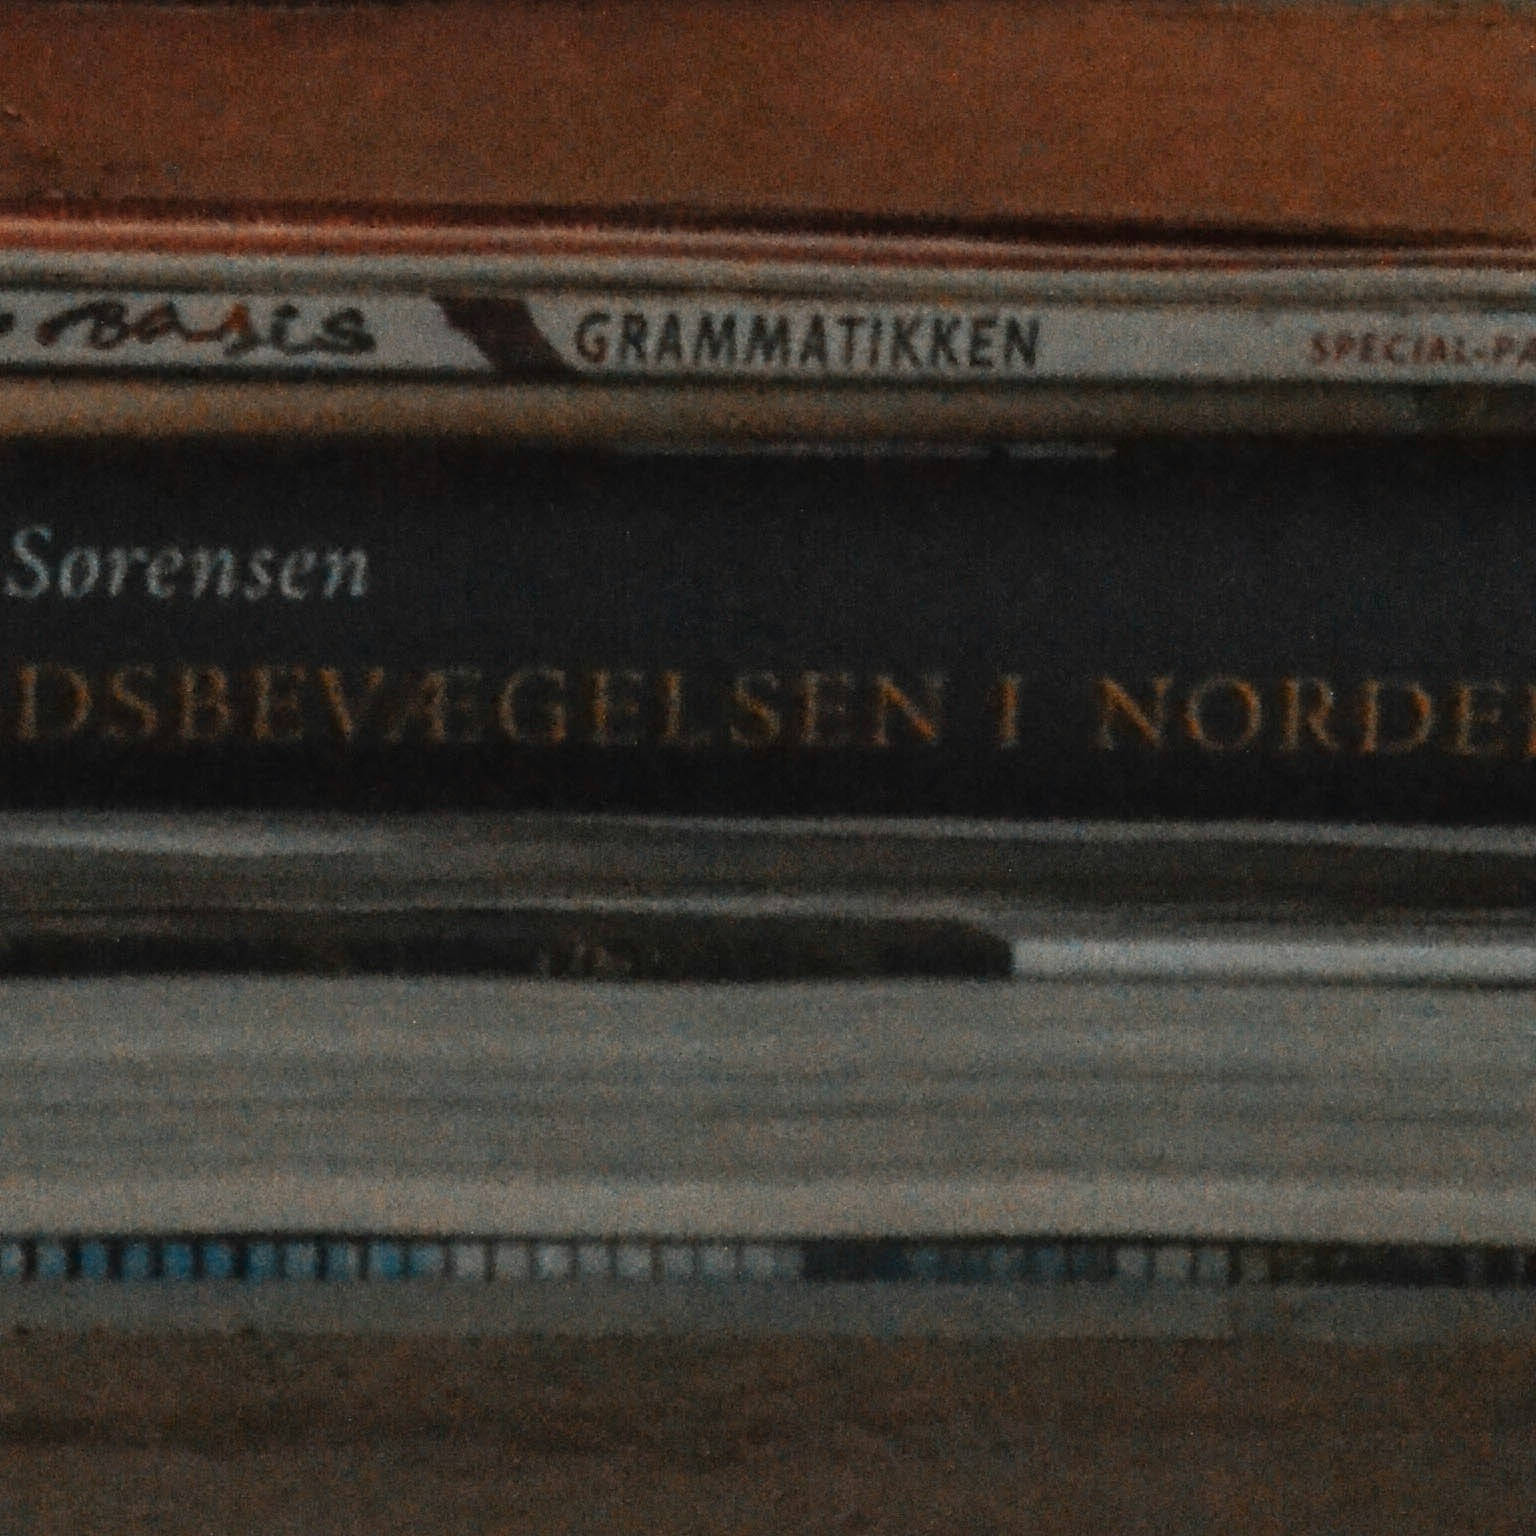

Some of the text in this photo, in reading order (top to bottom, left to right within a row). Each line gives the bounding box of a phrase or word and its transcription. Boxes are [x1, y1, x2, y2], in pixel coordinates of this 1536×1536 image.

[572, 310, 1042, 373] GRAMMATIKKEN
[994, 672, 1025, 748] I
[1094, 672, 1536, 754] NORDE
